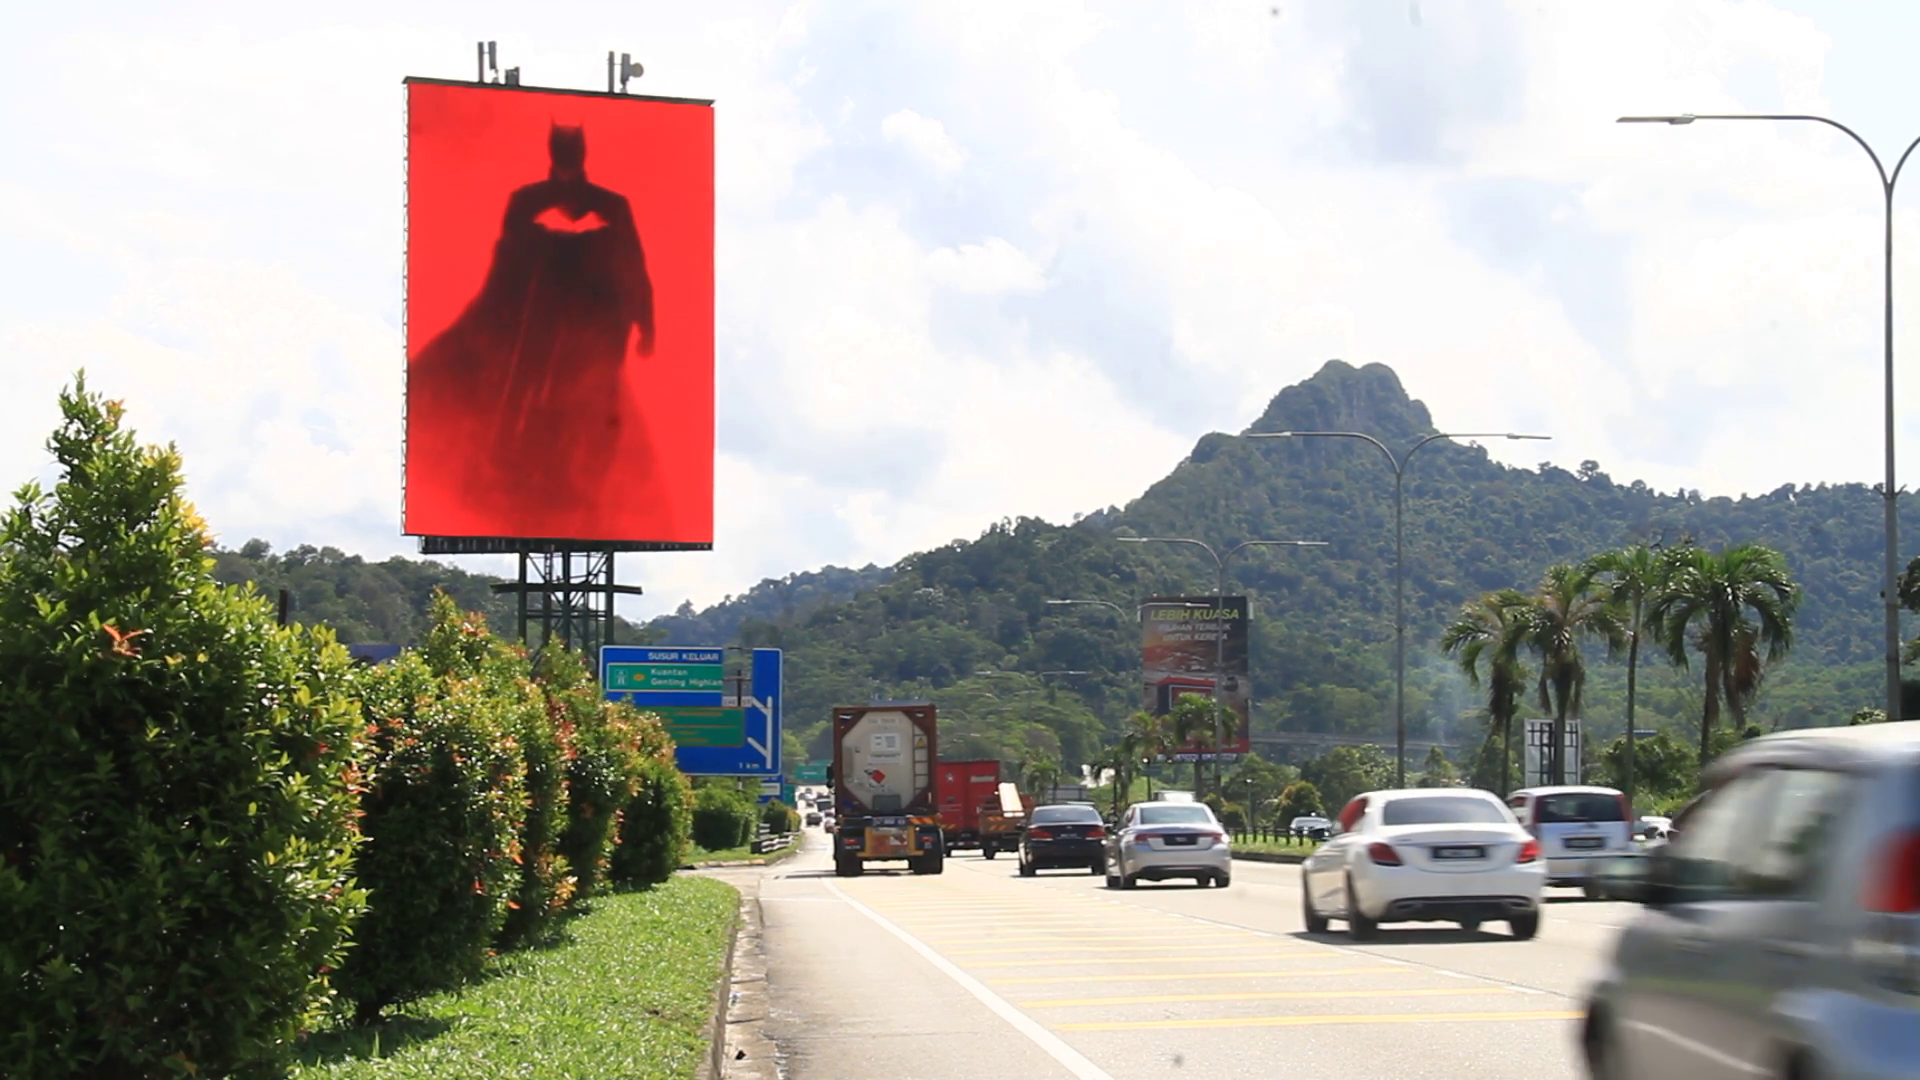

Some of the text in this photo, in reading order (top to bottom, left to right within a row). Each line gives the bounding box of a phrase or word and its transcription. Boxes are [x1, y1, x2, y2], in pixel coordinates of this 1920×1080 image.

[1150, 608, 1240, 620] LEBIH KUASA
[648, 652, 719, 661] SUSUR KELUAR
[651, 668, 688, 676] Kuantan
[651, 678, 685, 687] Genting
